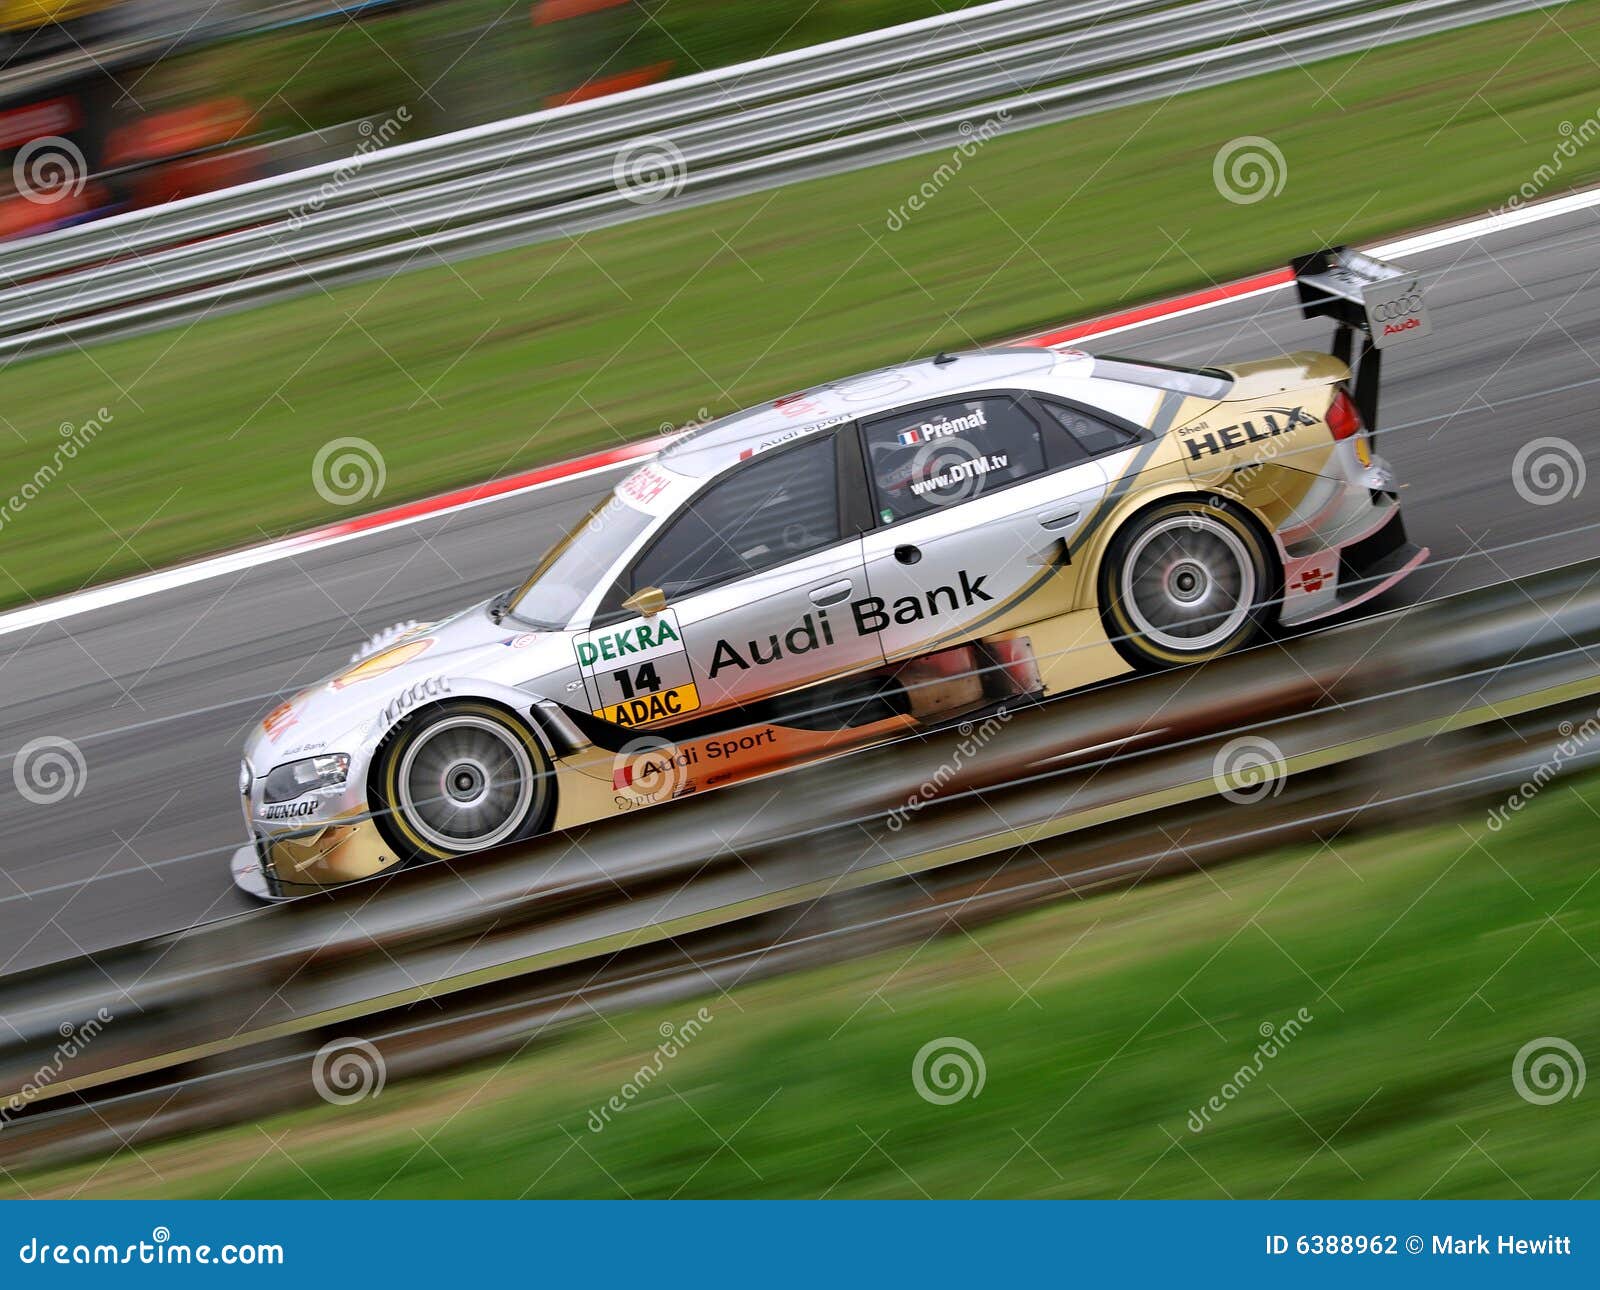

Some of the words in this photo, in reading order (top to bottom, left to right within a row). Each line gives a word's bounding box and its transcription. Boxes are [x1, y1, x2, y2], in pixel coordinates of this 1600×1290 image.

[1383, 318, 1421, 336] Audi
[759, 427, 799, 450] Audi
[803, 414, 854, 432] Sport
[920, 408, 988, 442] Prémat
[1178, 421, 1209, 437] Shell
[1183, 406, 1322, 461] HELIX
[910, 454, 1008, 495] www.DTM.tv
[577, 619, 679, 667] DEKRA
[707, 612, 833, 680] Audi
[852, 570, 994, 637] Bank
[613, 661, 663, 700] 14
[615, 689, 682, 727] ADAC
[640, 742, 699, 779] Audi
[705, 728, 777, 762] Sport
[266, 800, 319, 819] DUNLOP
